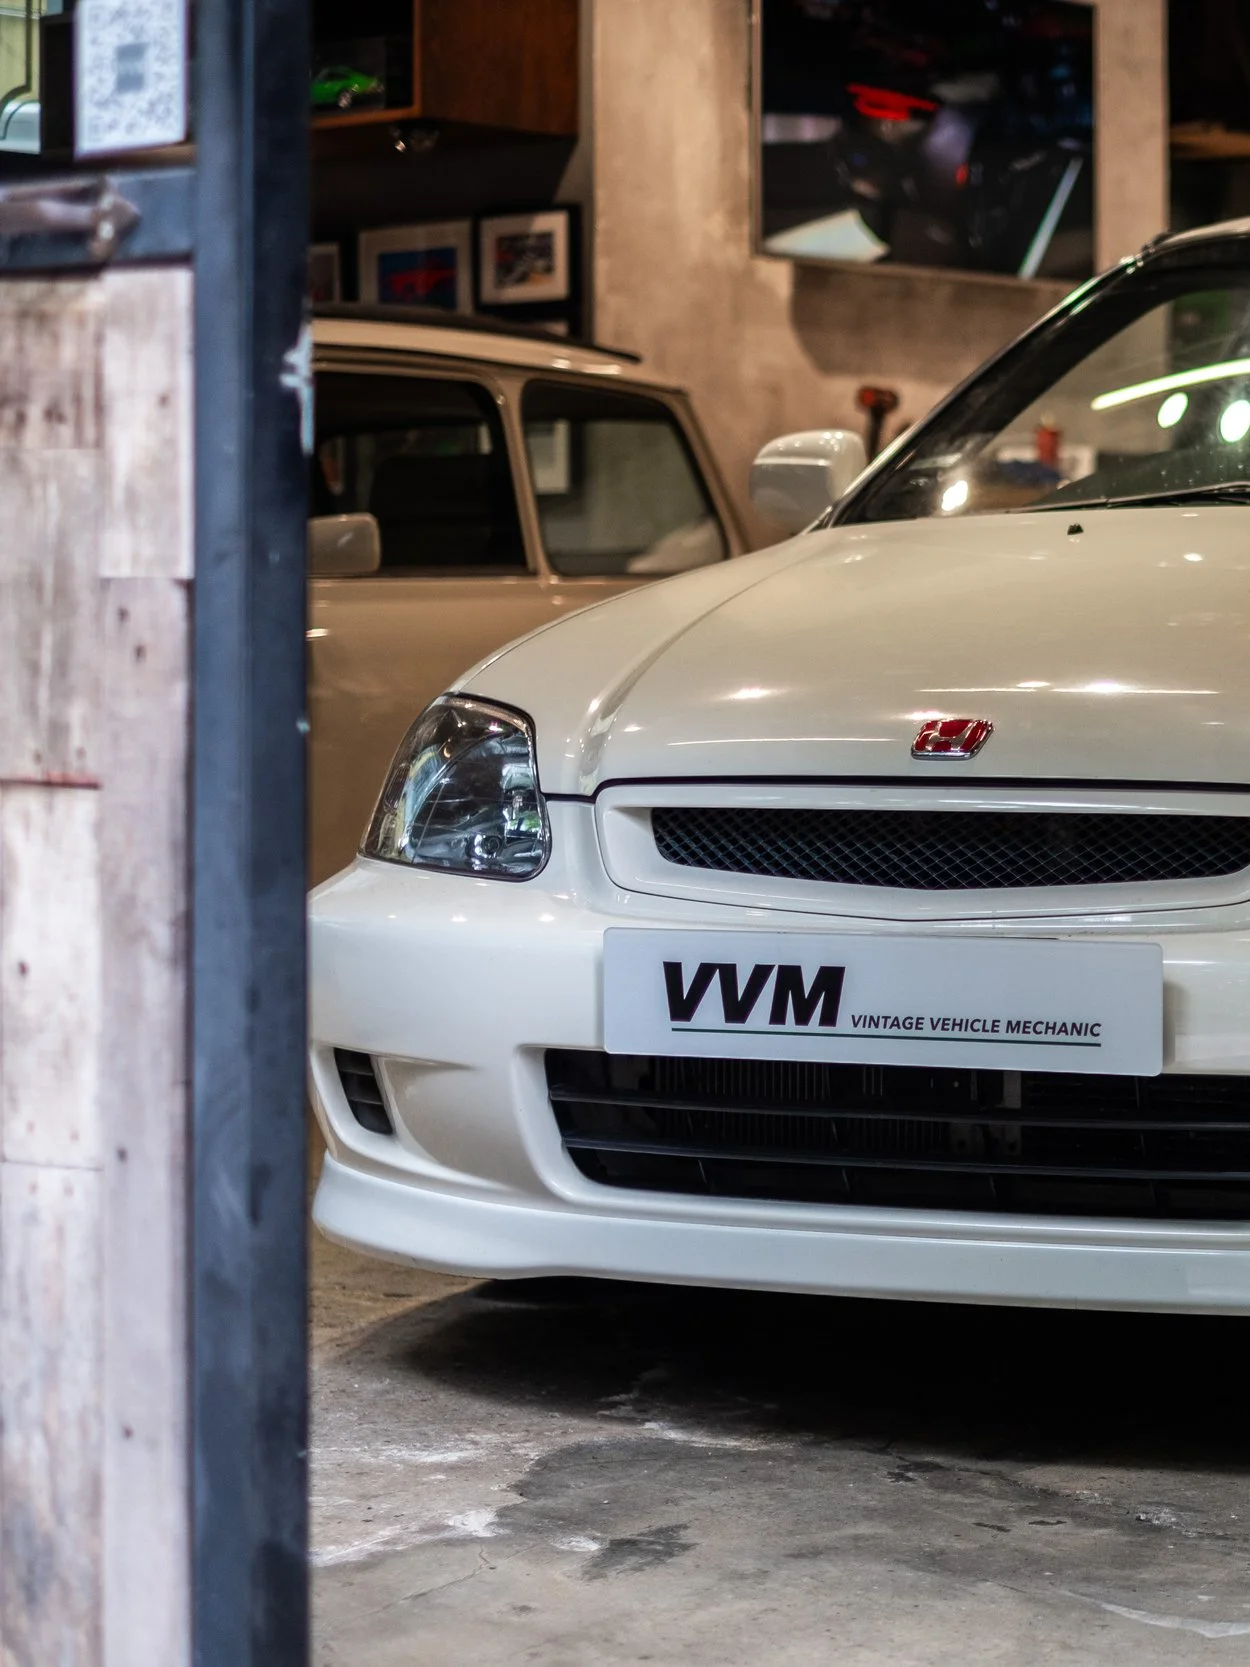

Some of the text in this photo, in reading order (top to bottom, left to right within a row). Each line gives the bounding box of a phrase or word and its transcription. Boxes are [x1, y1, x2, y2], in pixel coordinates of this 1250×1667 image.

[662, 960, 1102, 1038] VVM VINTAGE VEHICLE MECHANIC
